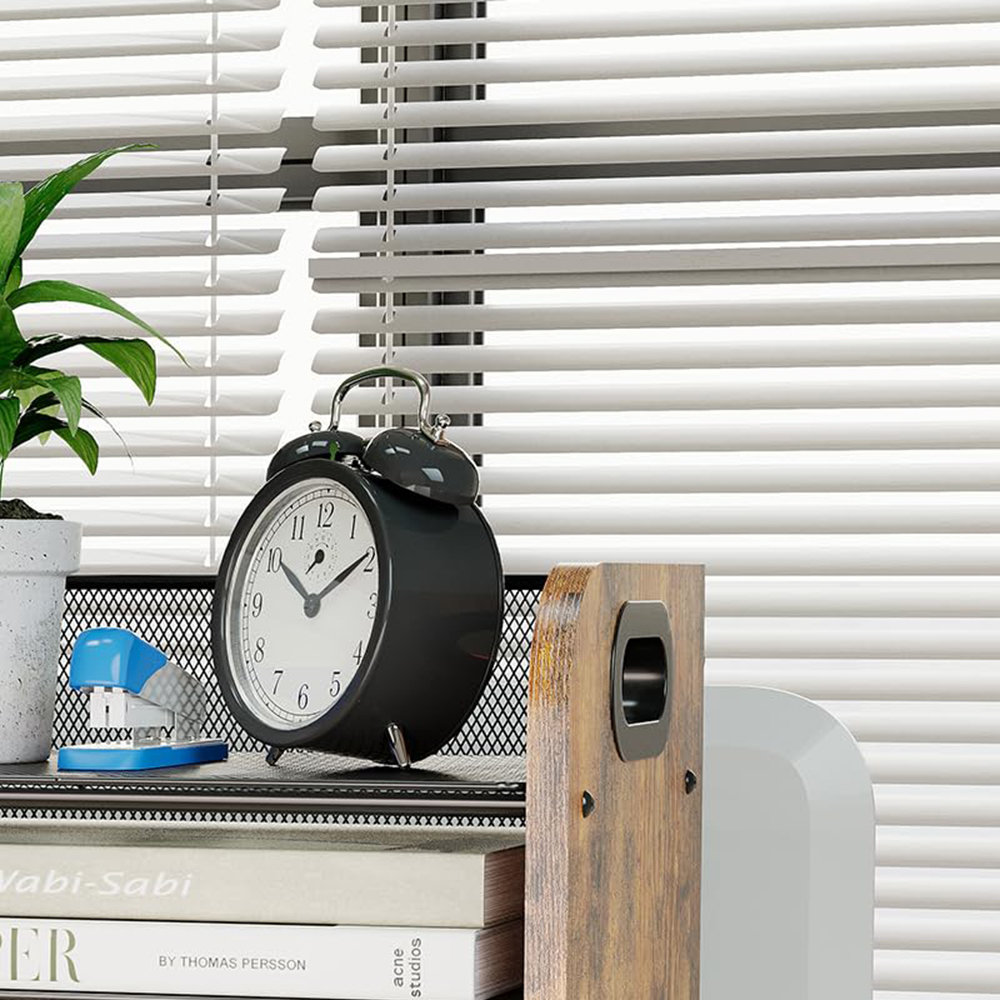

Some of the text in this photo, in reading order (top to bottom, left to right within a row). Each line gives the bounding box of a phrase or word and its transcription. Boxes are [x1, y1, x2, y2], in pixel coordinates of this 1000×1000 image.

[291, 515, 305, 540] 11
[316, 501, 334, 528] 12
[349, 515, 357, 539] 1
[267, 547, 282, 573] 10
[363, 546, 375, 573] 2
[252, 593, 263, 617] 9
[367, 593, 377, 619] 3
[254, 638, 265, 662] 8
[352, 640, 363, 665] 4
[272, 670, 283, 695] 7
[329, 671, 341, 697] 5
[298, 684, 309, 710] 6
[158, 955, 178, 970] BY
[182, 956, 237, 971] THOMAS
[241, 957, 306, 973] PERSSON
[392, 947, 406, 987] acne
[411, 938, 423, 997] studios
